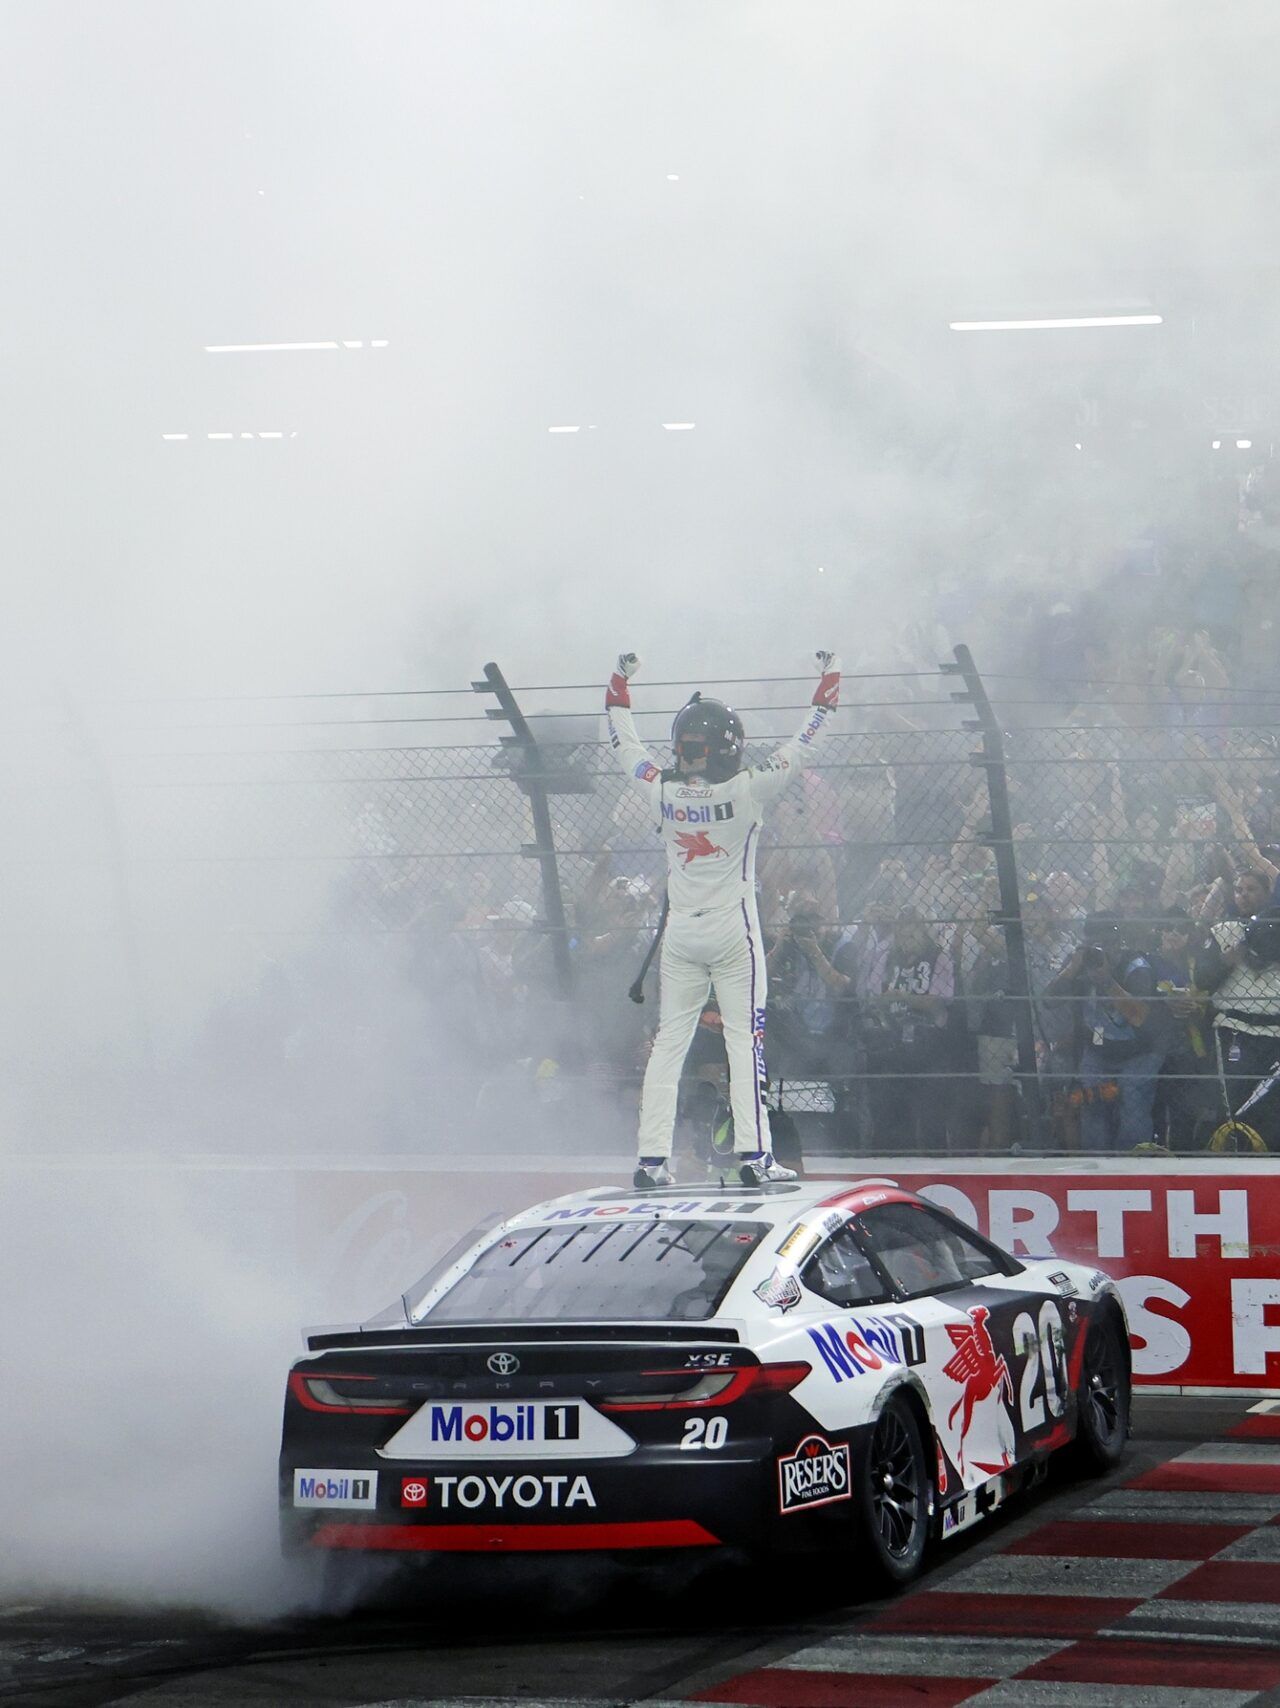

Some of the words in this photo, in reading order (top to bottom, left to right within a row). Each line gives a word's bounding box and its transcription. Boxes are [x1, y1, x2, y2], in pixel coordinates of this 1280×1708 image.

[798, 711, 825, 745] Mobil
[660, 803, 711, 824] Mobil
[916, 1184, 1250, 1258] RTH
[684, 1353, 733, 1368] XSE
[806, 1316, 901, 1384] Mobil
[1012, 1300, 1070, 1432] 20
[430, 1406, 535, 1442] Mobil
[680, 1417, 728, 1450] 20
[299, 1477, 349, 1501] Mobil
[434, 1475, 597, 1508] TOYOTA
[783, 1451, 846, 1505] RESER'S
